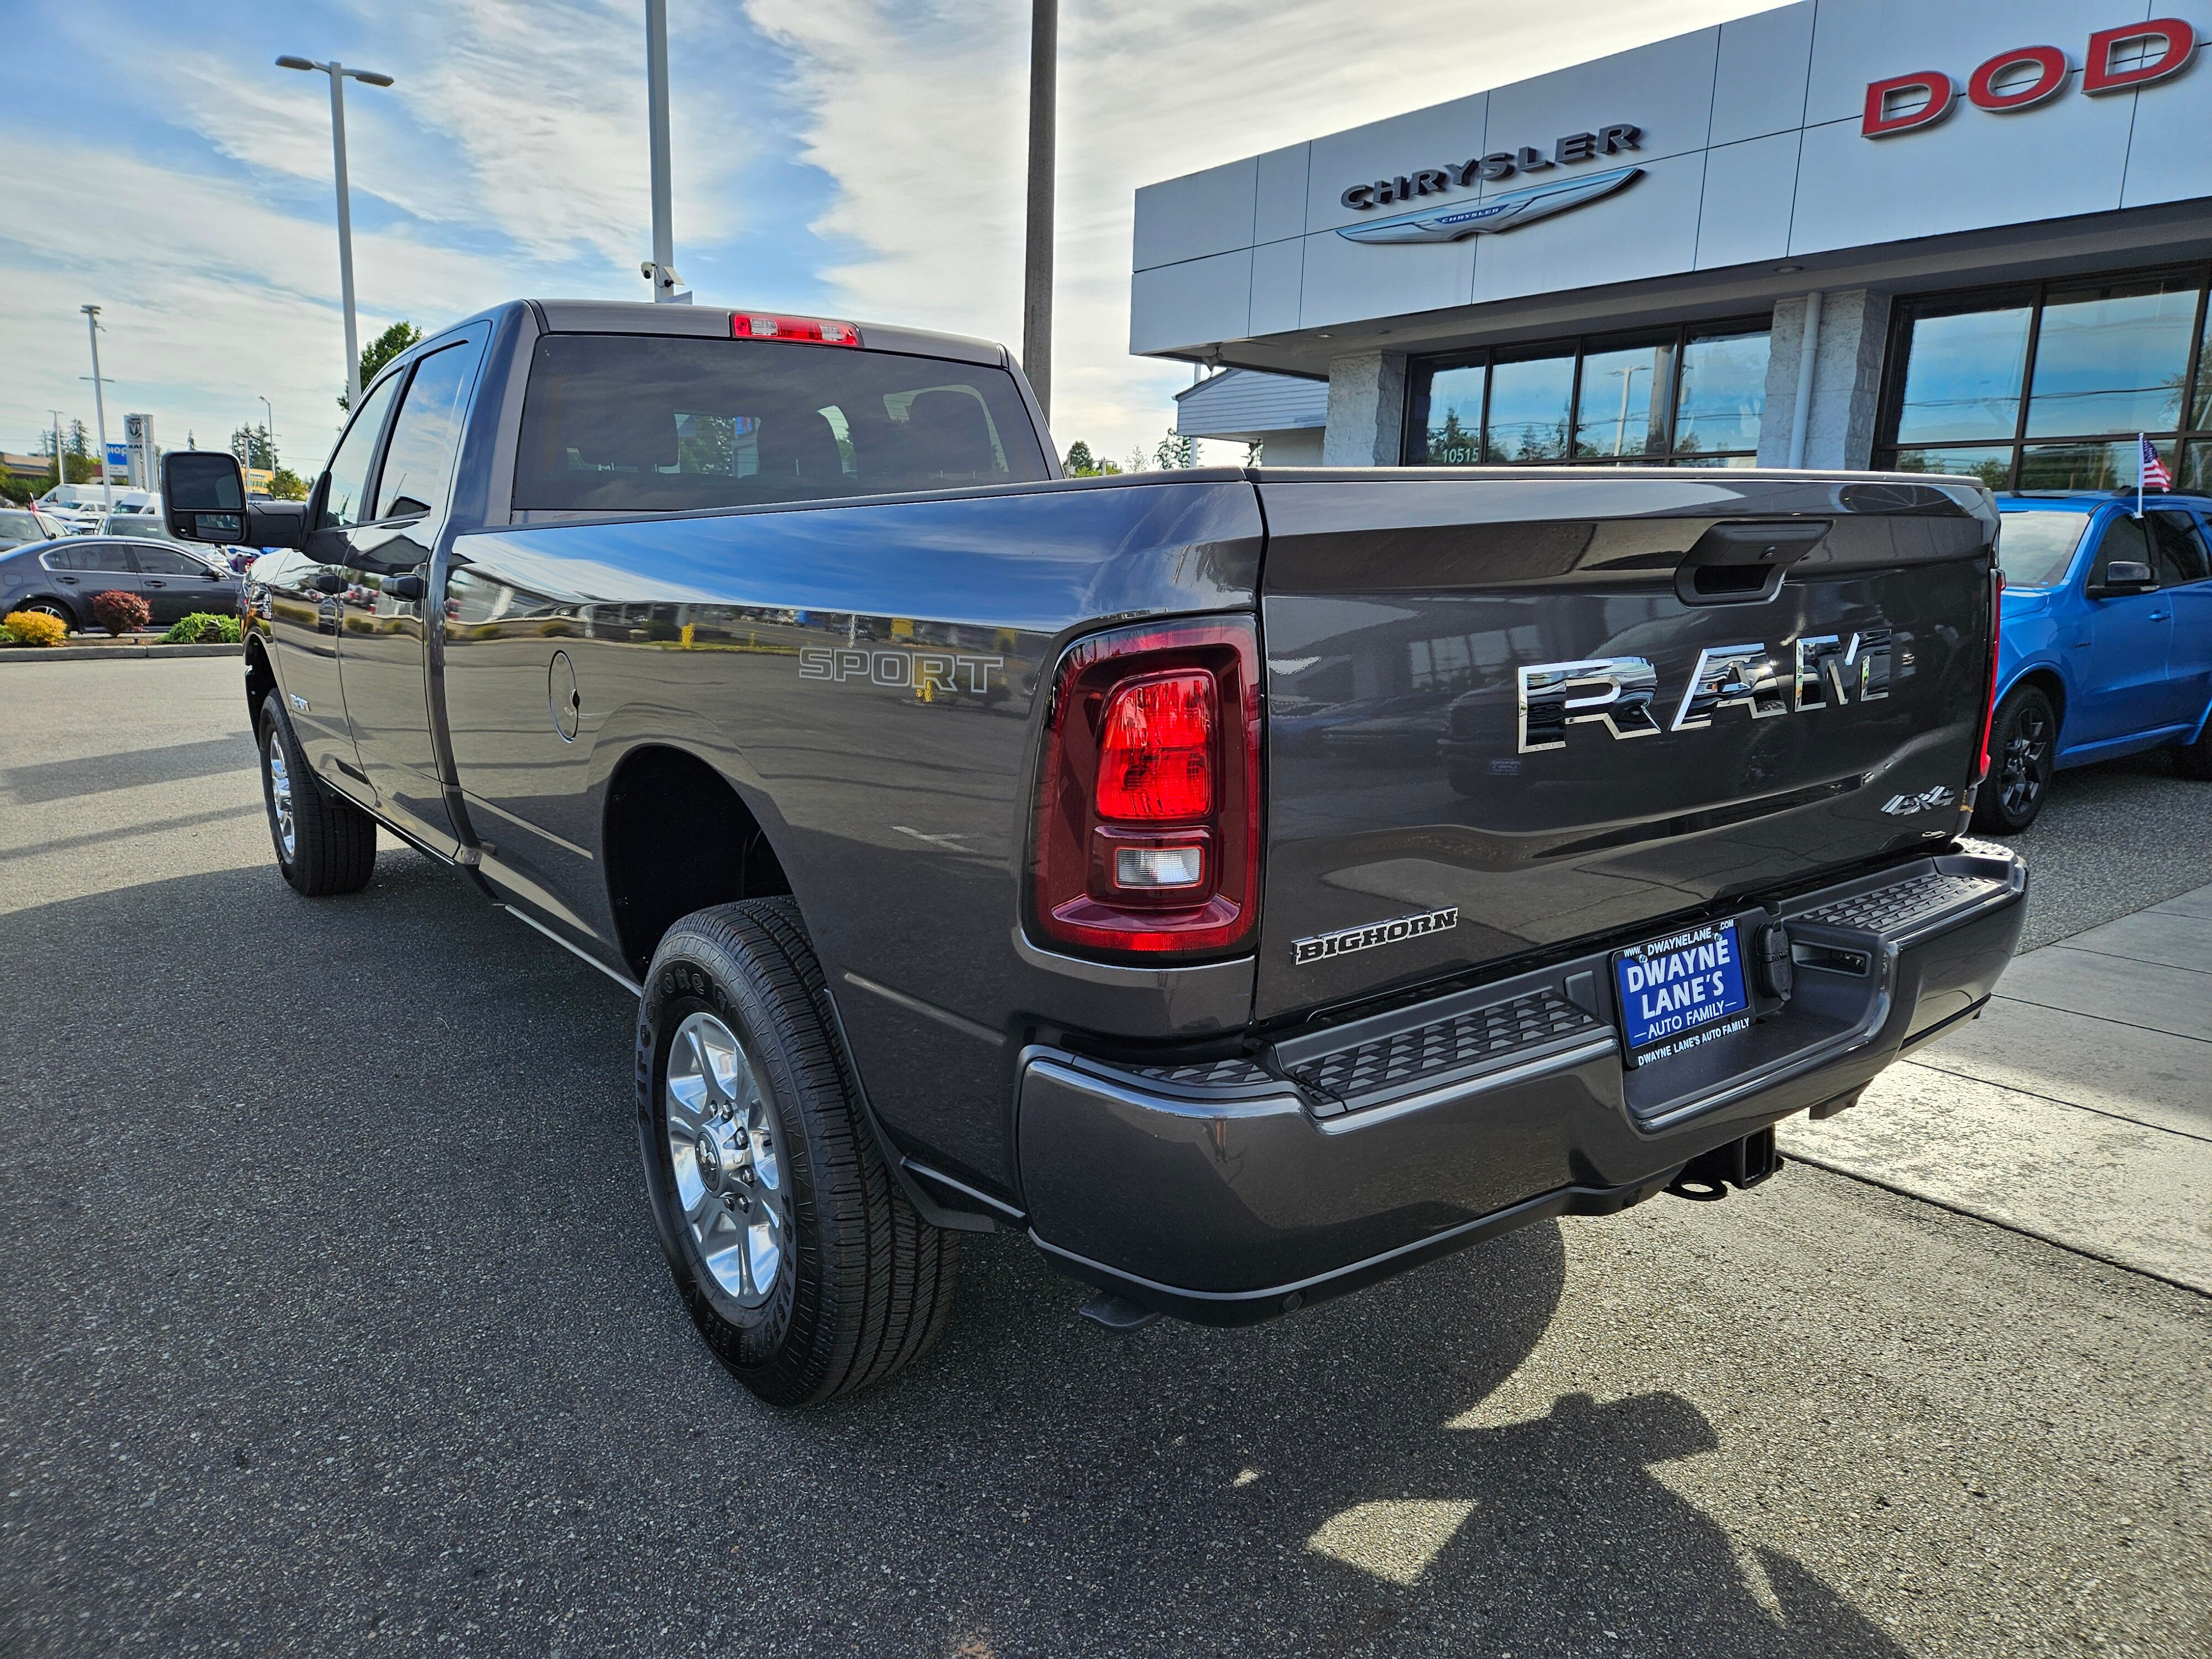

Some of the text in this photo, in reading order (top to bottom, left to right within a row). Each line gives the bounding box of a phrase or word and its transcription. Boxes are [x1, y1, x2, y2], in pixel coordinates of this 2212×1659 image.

[1340, 123, 1642, 210] CHRYSLER
[1442, 208, 1499, 223] CHRYSLER
[1442, 448, 1479, 463] 10515
[799, 646, 1004, 693] SPORT
[1517, 629, 1892, 754] RAM
[1292, 906, 1458, 965] BIGHORN
[1647, 927, 1712, 956] DWAYNELANE
[1627, 939, 1730, 993] DWAYNE
[1642, 971, 1724, 1020] LANE'S
[1648, 1000, 1724, 1039] AUTO FAMILY
[1637, 1018, 1750, 1067] DWAYNE LANE'S AUTO FAMILY
